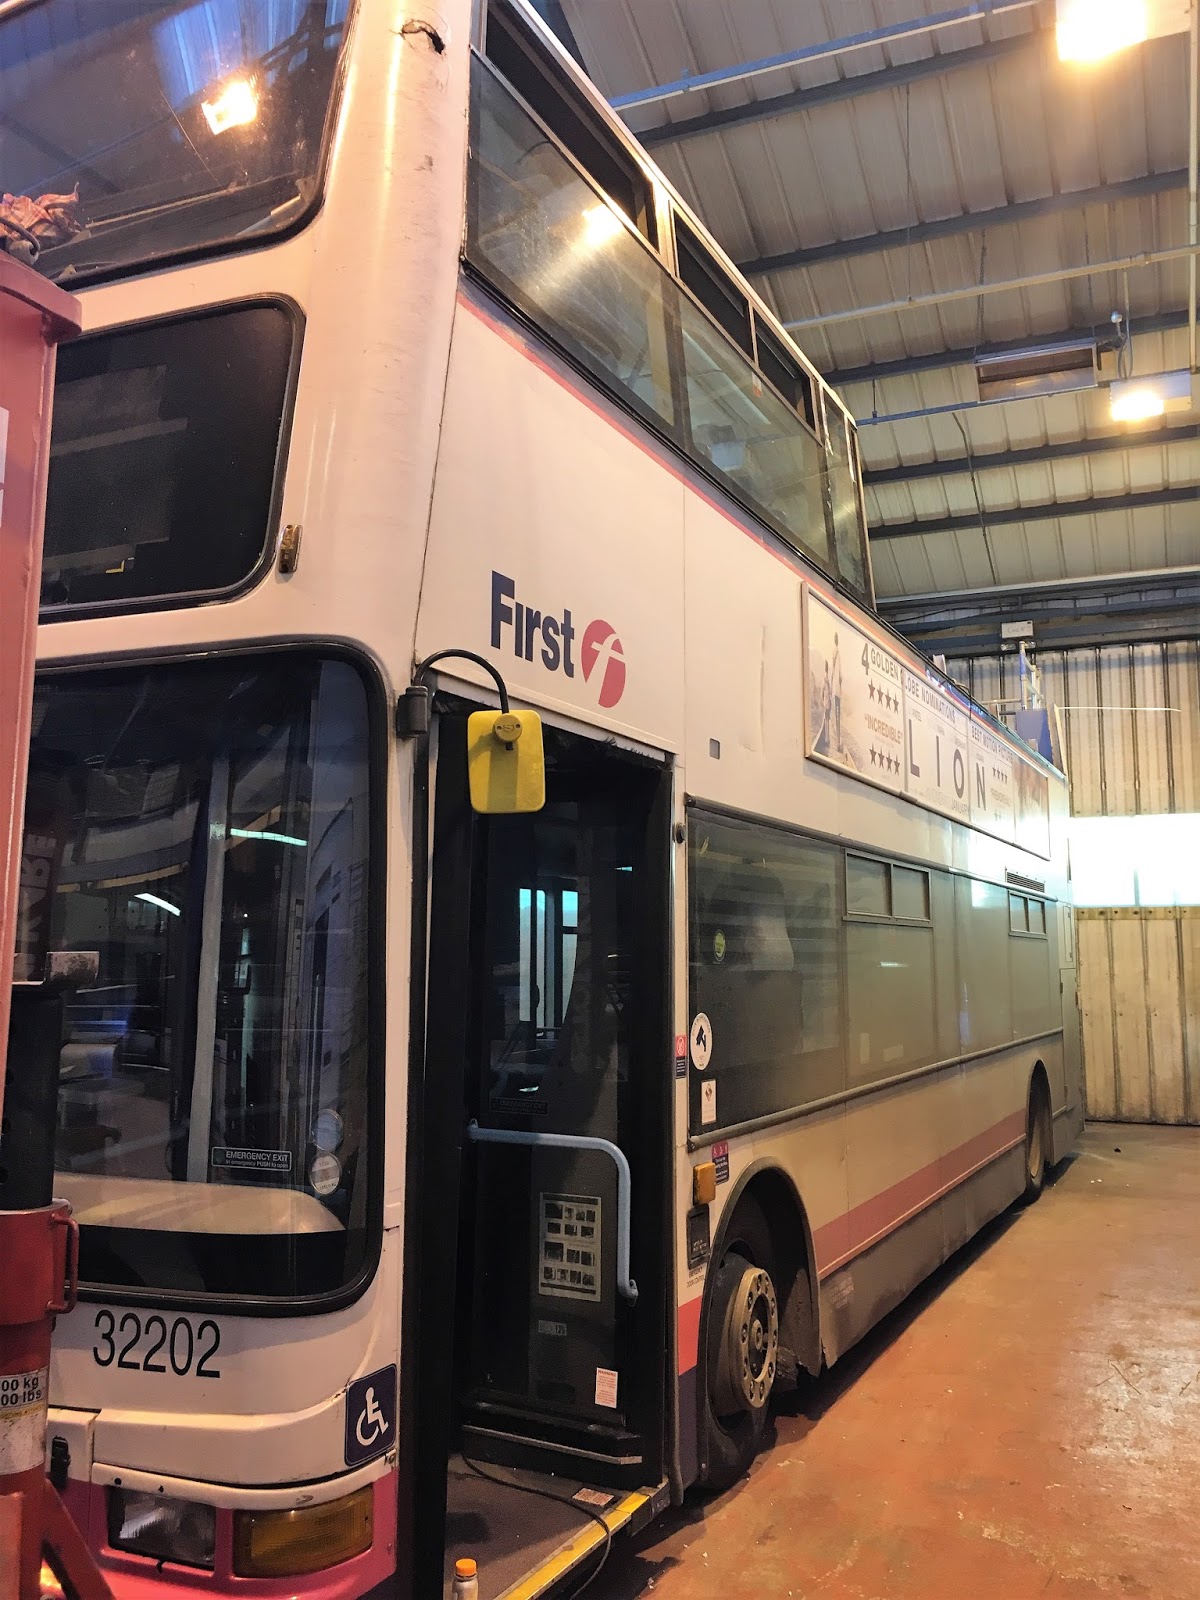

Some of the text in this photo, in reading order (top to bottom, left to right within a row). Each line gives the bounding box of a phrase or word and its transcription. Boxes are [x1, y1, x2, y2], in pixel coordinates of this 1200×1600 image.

[490, 569, 575, 679] First
[861, 642, 870, 675] 4
[870, 647, 899, 680] GOLDEN
[921, 687, 956, 723] NOMINATIONS
[226, 1150, 288, 1162] EMERGENCY EXIT
[230, 1159, 256, 1167] emergency
[92, 1309, 221, 1379] 32202
[23, 1376, 39, 1390] kg
[22, 1389, 42, 1403] lbs
